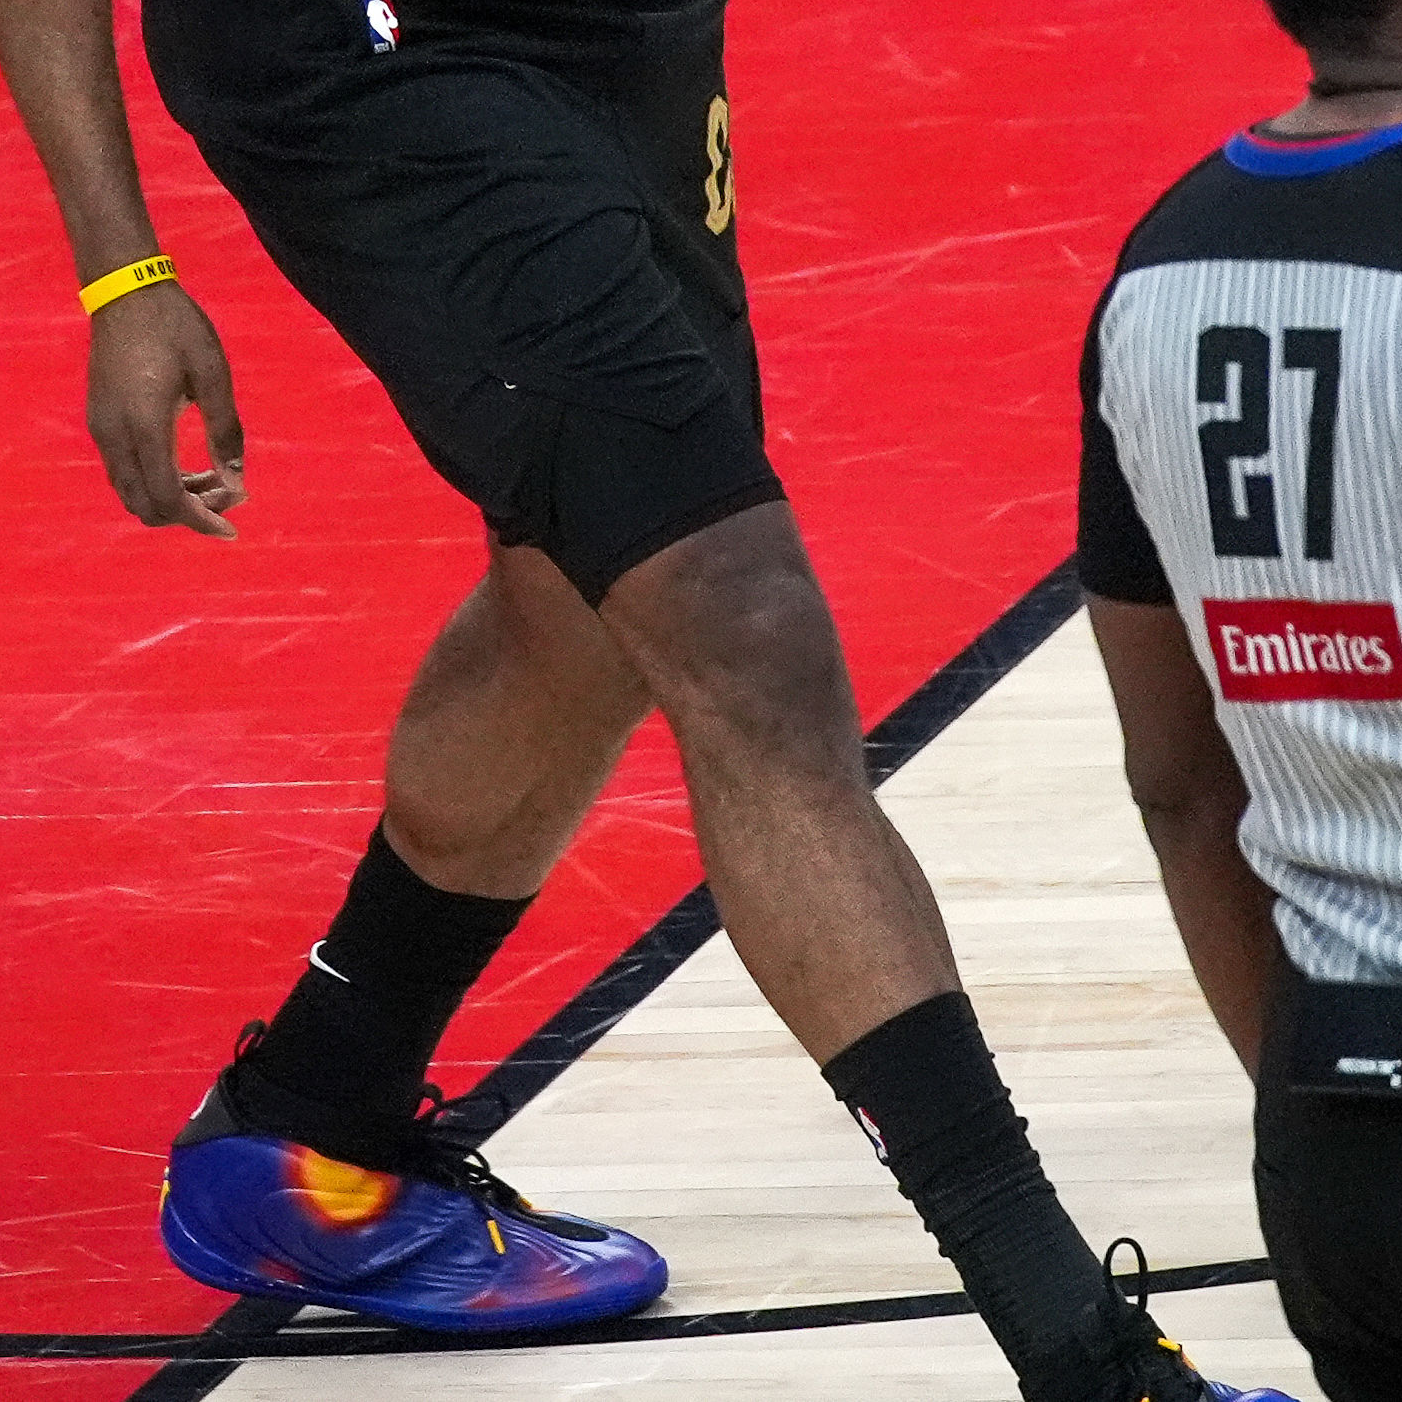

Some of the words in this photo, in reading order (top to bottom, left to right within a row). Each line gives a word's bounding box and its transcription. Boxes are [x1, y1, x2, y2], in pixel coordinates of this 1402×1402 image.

[133, 259, 176, 281] UNDE
[1198, 325, 1341, 561] 27
[1220, 621, 1394, 675] Emirates
